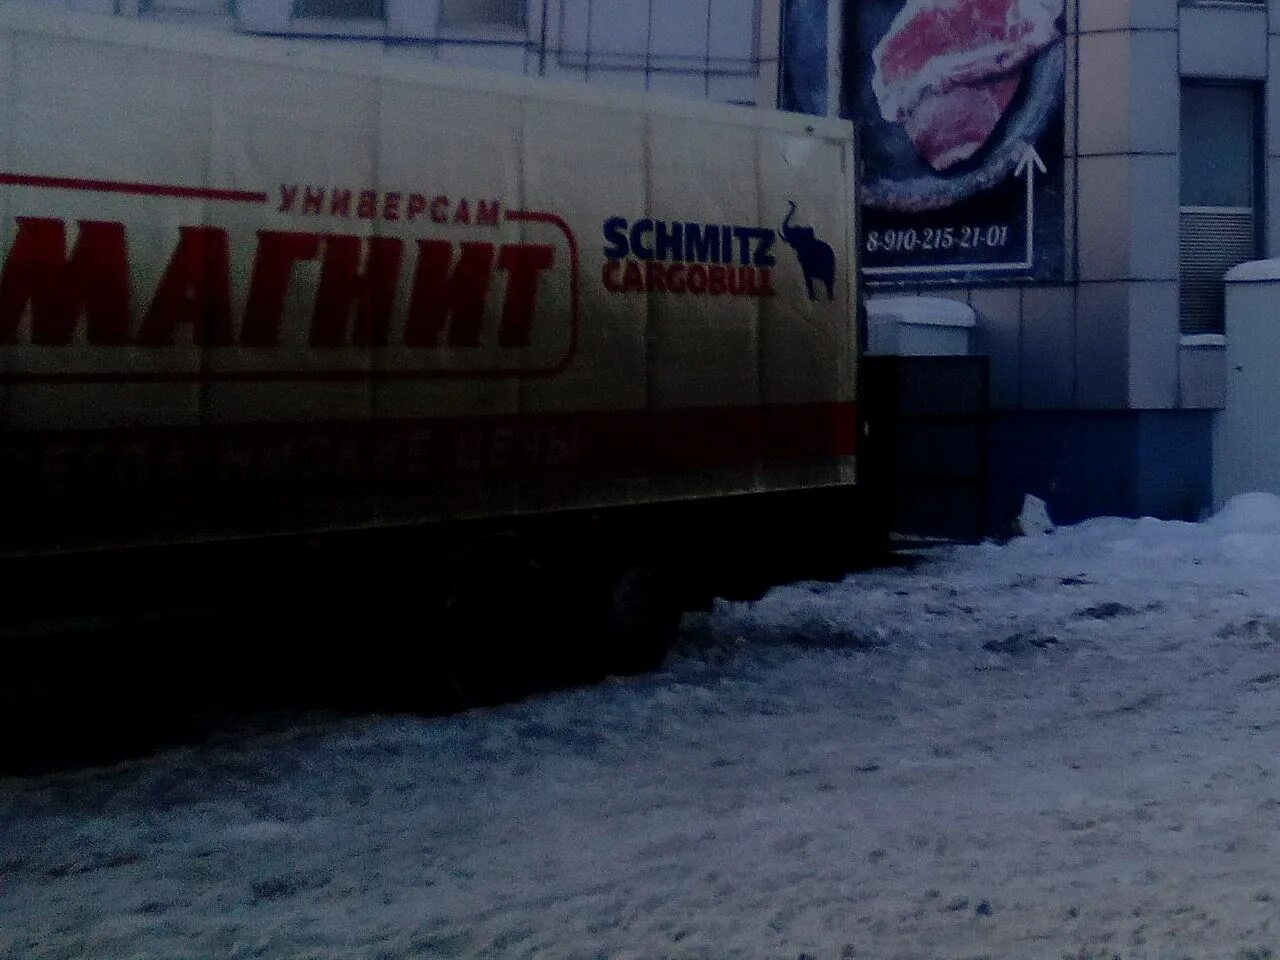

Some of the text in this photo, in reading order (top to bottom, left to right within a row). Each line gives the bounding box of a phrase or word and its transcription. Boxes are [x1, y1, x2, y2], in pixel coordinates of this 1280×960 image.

[279, 183, 501, 226] УНИВЕРСАМ
[603, 216, 776, 266] SCHMITZ
[0, 216, 554, 348] МАГНИТ
[602, 260, 775, 296] CARGOBULL
